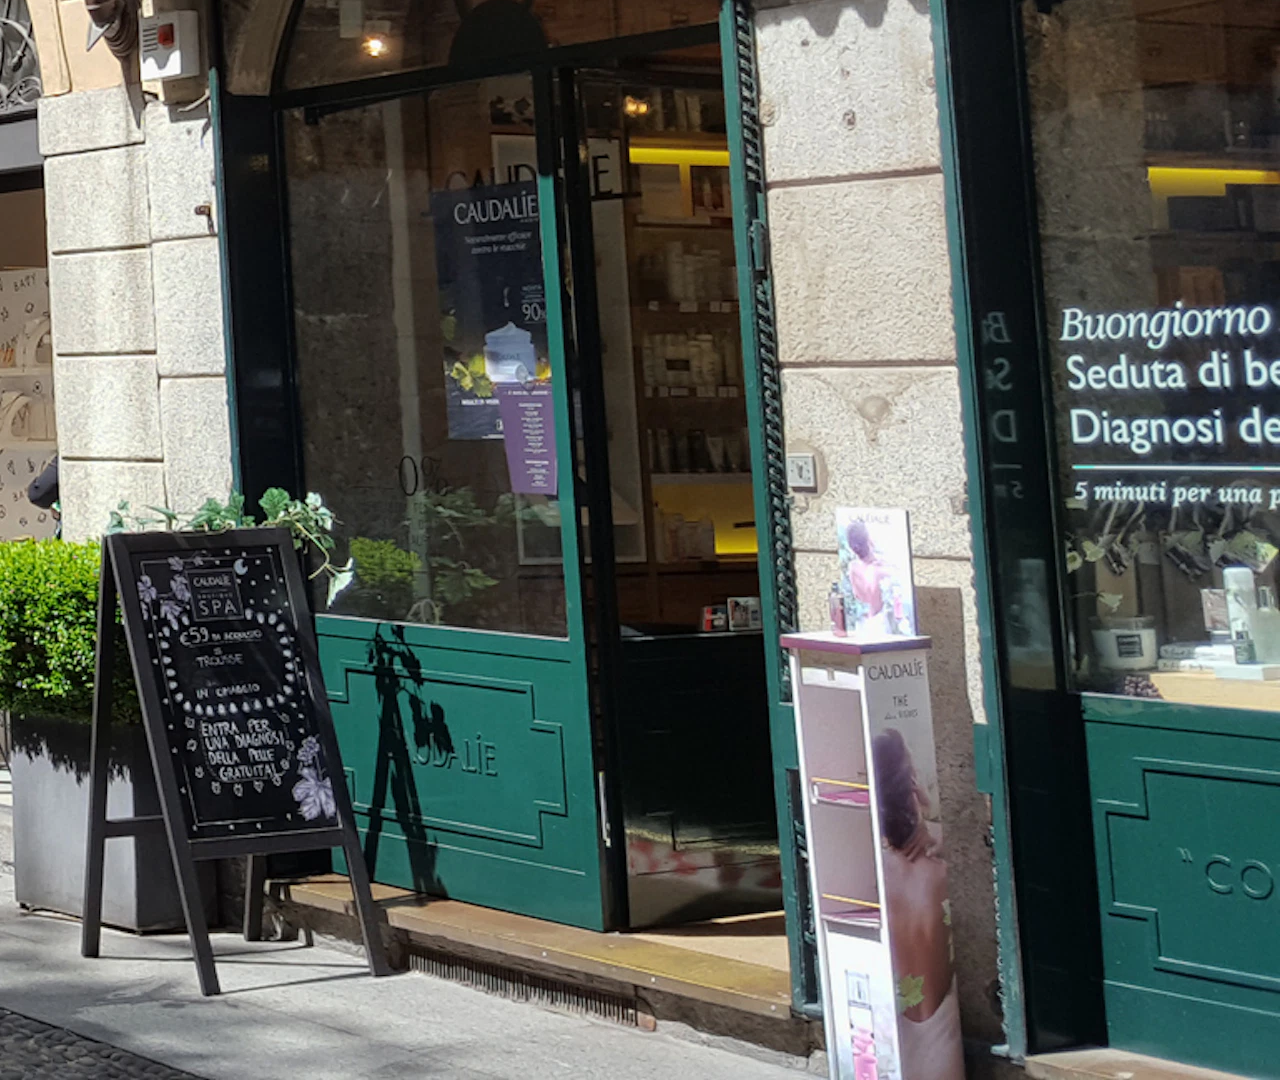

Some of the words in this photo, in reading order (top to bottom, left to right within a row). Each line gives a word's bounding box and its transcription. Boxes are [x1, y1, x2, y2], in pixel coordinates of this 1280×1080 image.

[453, 190, 539, 225] CAUDALIE
[1059, 300, 1272, 350] Buongiorno
[1066, 353, 1187, 391] Seduta
[1198, 350, 1232, 388] di
[1069, 407, 1224, 455] Diagnosi
[1074, 480, 1088, 500] 5
[1093, 480, 1167, 501] minuti
[1171, 485, 1211, 508] per
[1218, 486, 1263, 504] una
[198, 599, 238, 616] SPA
[180, 626, 209, 646] €59
[867, 657, 925, 681] CAUDALIE
[196, 688, 209, 700] IN
[200, 721, 240, 737] ENTRA
[247, 718, 271, 734] PER
[204, 738, 230, 751] UNA
[234, 730, 286, 749] DIAGNOSI
[208, 751, 240, 766] DELLA
[247, 748, 276, 762] PELLE
